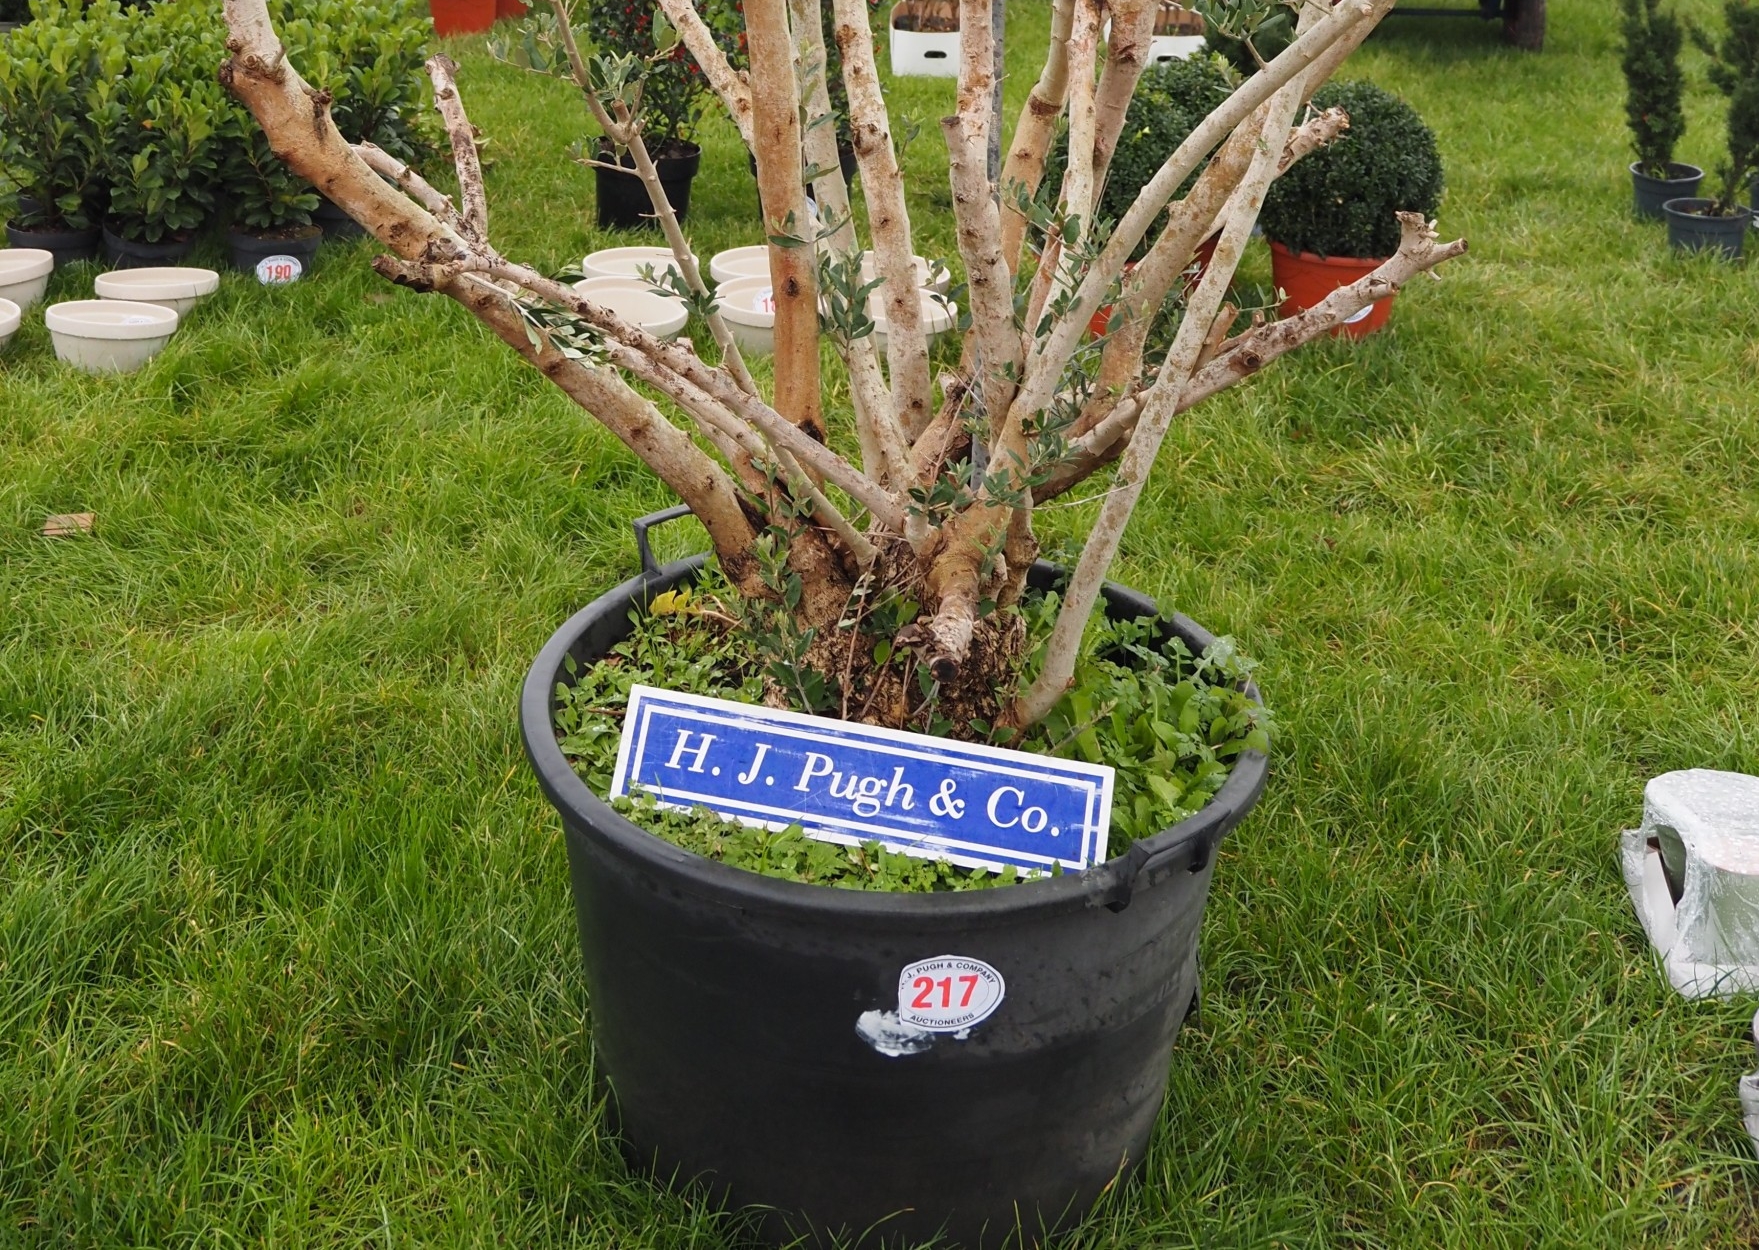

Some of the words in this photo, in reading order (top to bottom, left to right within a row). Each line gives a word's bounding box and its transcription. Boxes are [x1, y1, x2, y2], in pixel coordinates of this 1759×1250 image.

[266, 264, 292, 280] 190
[665, 729, 720, 776] H.
[738, 742, 775, 786] J.
[793, 751, 915, 817] Pugh
[929, 778, 966, 820] &
[987, 786, 1061, 837] Co.
[916, 962, 944, 974] PUGH
[956, 962, 996, 984] COMPANY
[911, 974, 979, 1008] 217
[910, 1013, 974, 1025] AUCTIONEERS
